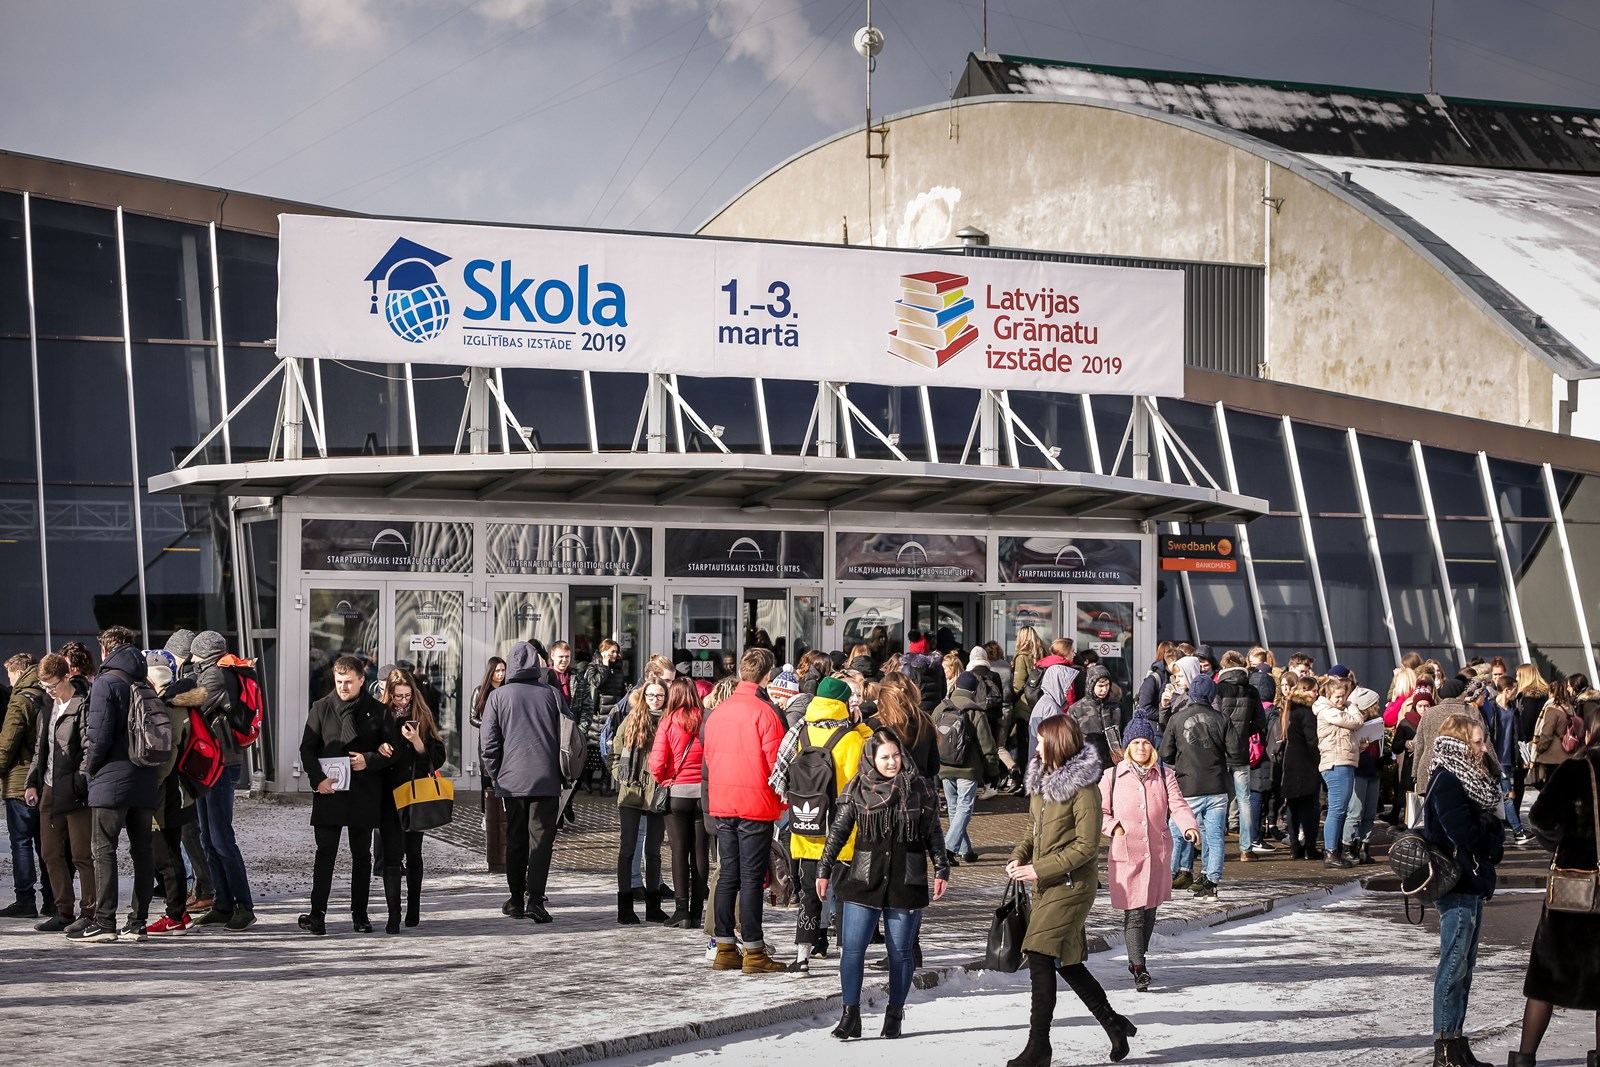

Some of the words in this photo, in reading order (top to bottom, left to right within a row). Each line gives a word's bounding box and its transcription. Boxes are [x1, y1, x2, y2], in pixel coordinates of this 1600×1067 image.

[463, 259, 628, 328] Skola
[986, 284, 1080, 318] Latvijas
[719, 323, 799, 347] martā
[993, 315, 1098, 345] Grāmatu
[463, 334, 523, 348] IZGLĪTĪBAS
[527, 337, 572, 350] IZSTĀDE
[581, 332, 627, 352] 2019
[986, 345, 1073, 373] izstāde
[1081, 355, 1123, 375] 2019
[1167, 540, 1216, 552] Swedbank
[327, 555, 390, 565] STARPTAUTISKAIS
[423, 557, 449, 566] CENTRS
[507, 560, 560, 569] INTERNATIONAL
[562, 560, 603, 569] EXHIBITION
[605, 561, 630, 570] CENTRE
[1195, 561, 1231, 570] BANKOMĀTS
[688, 563, 745, 572] STARPTAUTISKAIS
[747, 563, 774, 573] IZSTĀŽU
[776, 564, 801, 573] CENTRS
[848, 566, 906, 575] МЕЖДУНАРОДНЫЙ
[907, 567, 954, 576] ВЫСТАВОЧНЫЙ
[955, 568, 974, 576] ЦЕНТР
[1018, 570, 1071, 578] STARPTAUTISKAIS
[1072, 570, 1096, 579] IZSTĀŽU
[1098, 571, 1120, 579] CENTRS
[793, 822, 820, 830] adidas
